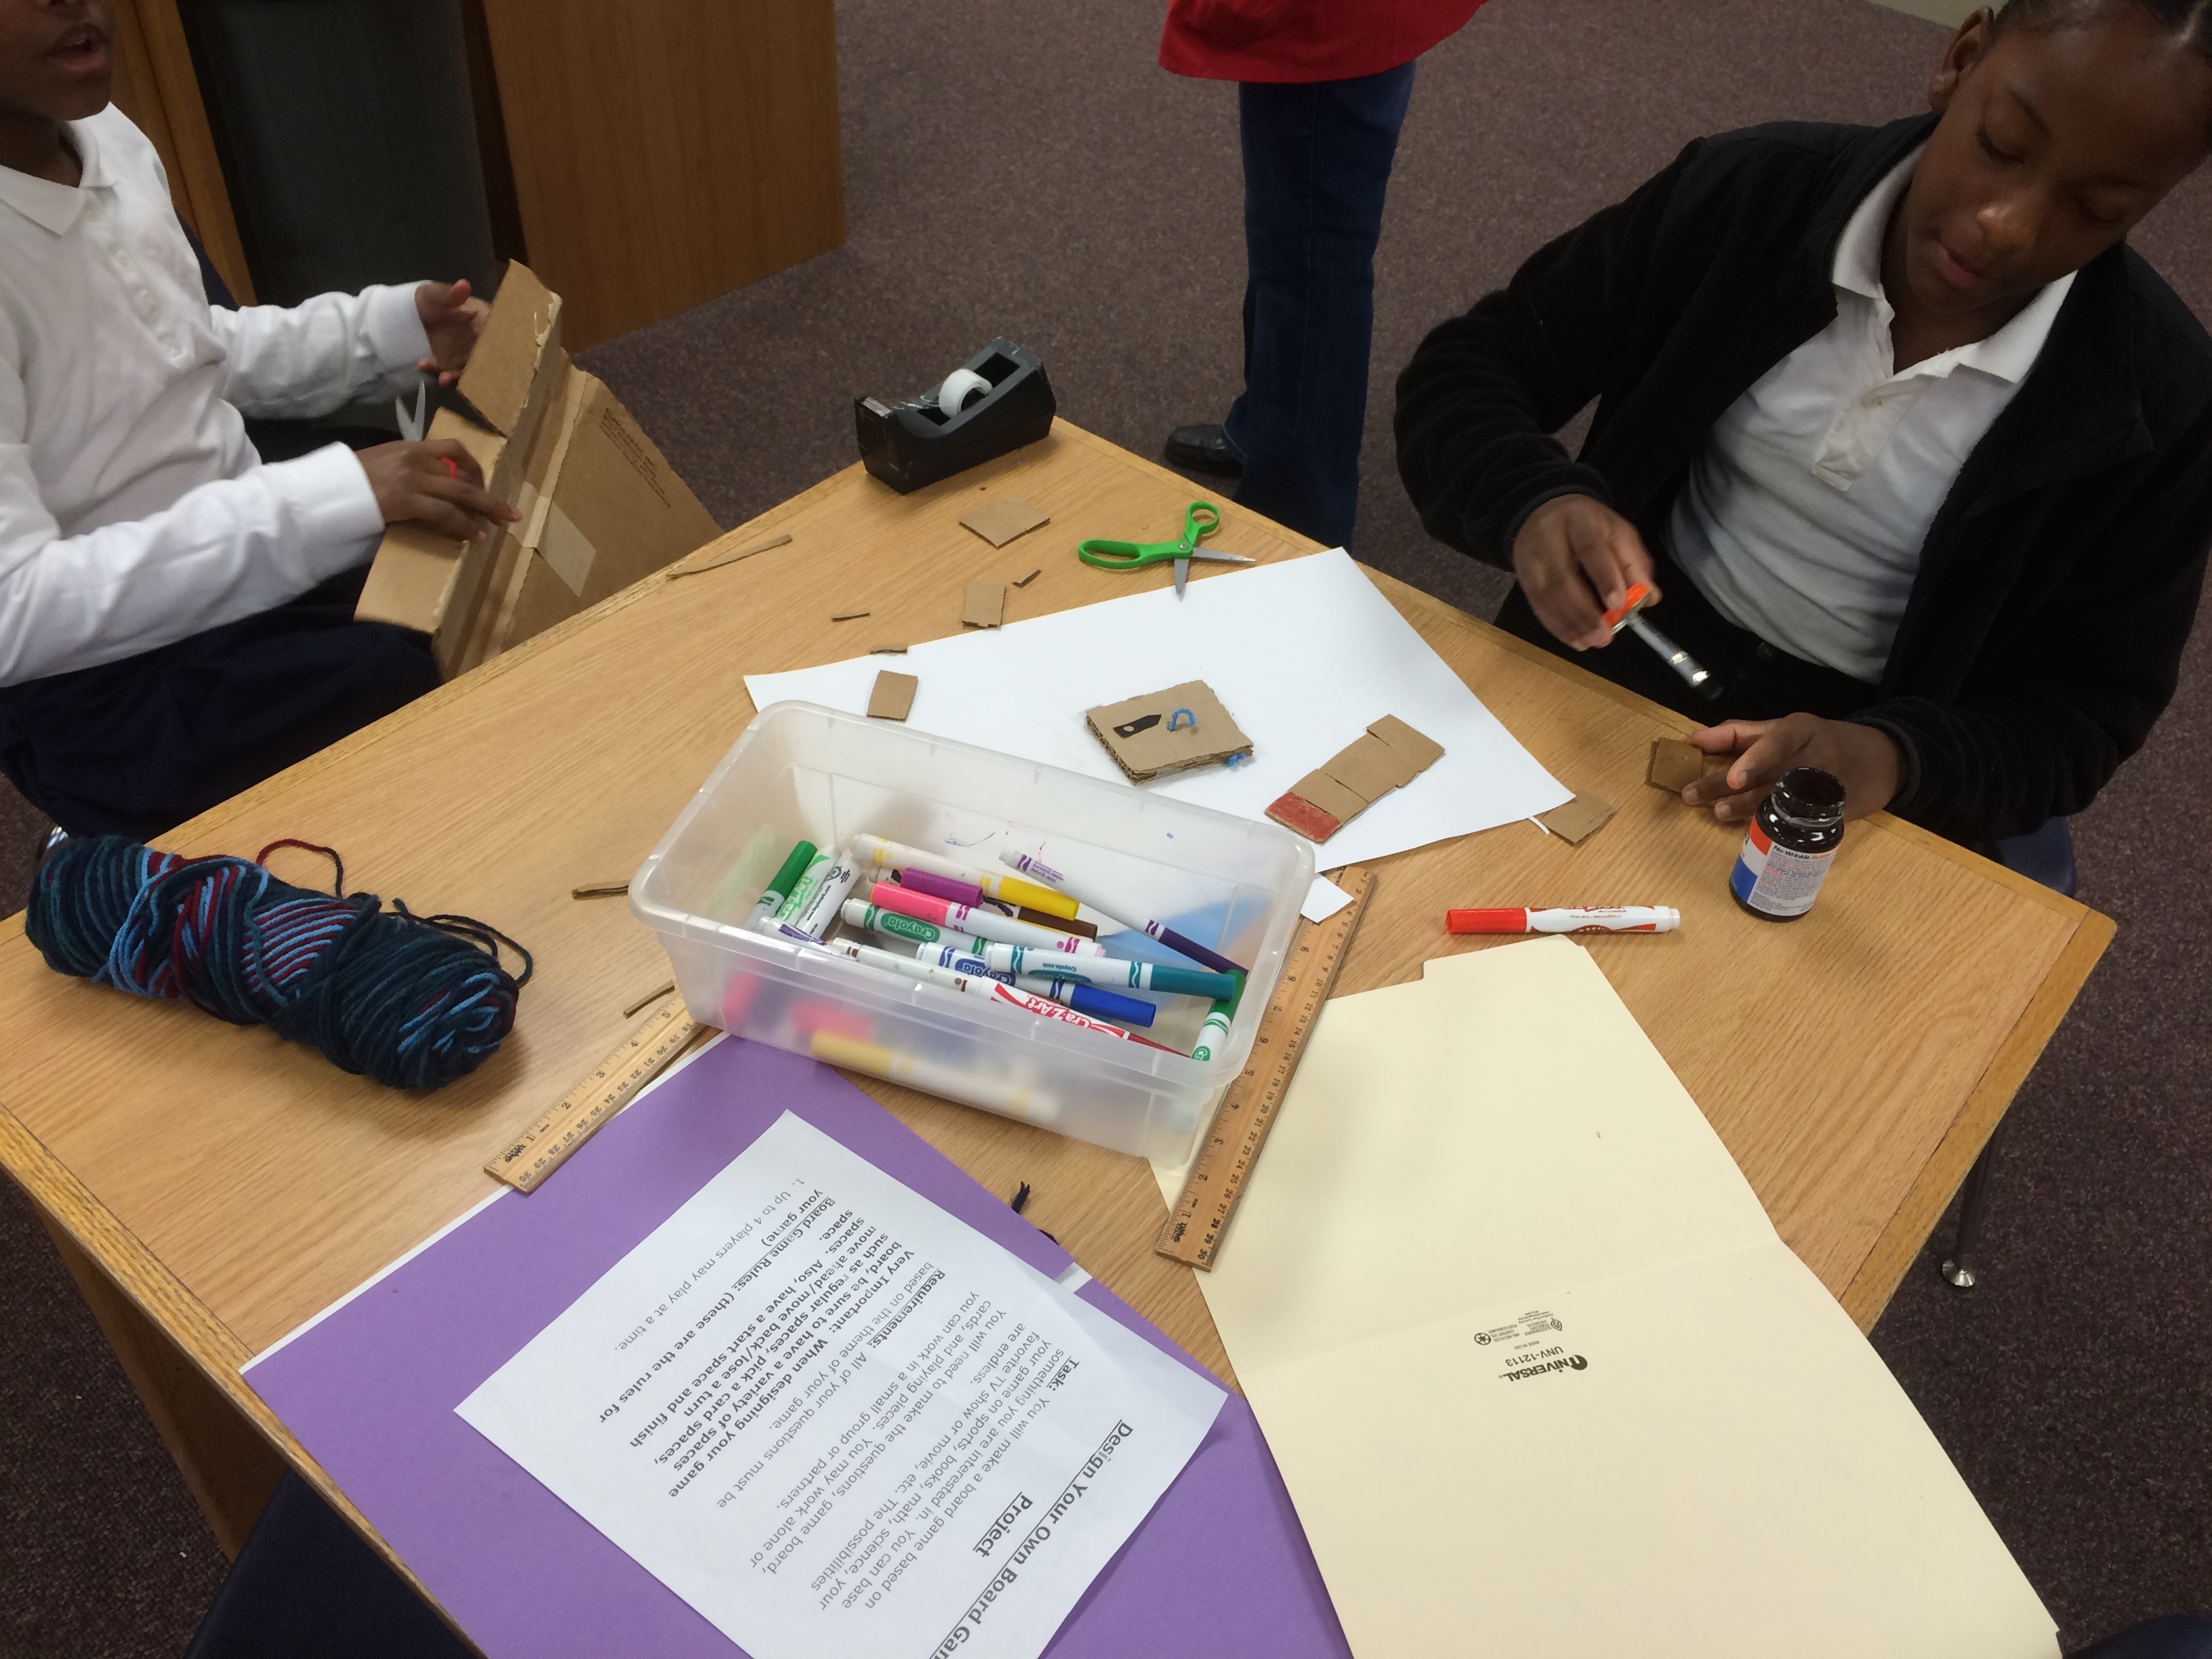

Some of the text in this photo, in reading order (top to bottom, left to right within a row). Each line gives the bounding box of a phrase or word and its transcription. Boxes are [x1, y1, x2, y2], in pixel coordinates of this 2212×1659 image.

[887, 916, 935, 941] Crayola
[962, 962, 1012, 986] Crayola
[1042, 962, 1077, 972] Crayola.com
[657, 1046, 668, 1055] 20
[1288, 1040, 1297, 1048] 15
[630, 1069, 642, 1079] 22
[590, 1106, 602, 1116] 25
[605, 1094, 615, 1103] 24
[1261, 1104, 1269, 1113] 20
[576, 1119, 588, 1128] 26
[774, 1191, 791, 1204] Up
[1224, 1188, 1233, 1199] 26
[1230, 1174, 1240, 1185] 25
[753, 1216, 761, 1225] 4
[761, 1189, 823, 1246] your game)
[819, 1209, 853, 1240] space.
[716, 1223, 753, 1258] players
[1197, 1249, 1208, 1259] 30
[692, 1258, 716, 1281] may
[599, 1196, 836, 1422] Board Game Rules: (these are the rules for
[653, 1304, 668, 1316] at
[668, 1280, 691, 1304] play
[615, 1326, 647, 1350] time.
[629, 1217, 864, 1447] spaces. Also, have start space and finish
[683, 1225, 876, 1416] move ahead/move back/lose turn
[654, 1233, 888, 1464] such as regular spaces, pick card spaces,
[673, 1241, 902, 1471] board, be sure have variety spaces
[769, 1262, 934, 1429] based the theme your game.
[970, 1323, 1025, 1383] are endless.
[1505, 1346, 1563, 1366] UNV-12113
[668, 1250, 914, 1496] Very Important: When designing your game
[716, 1267, 945, 1507] Requirements: All your questions must be
[777, 1291, 979, 1508] you can work in small group partners.
[762, 1300, 991, 1550] cards, and playing pieces. You may work alone
[762, 1310, 1006, 1574] You will need make the questions, game board,
[811, 1331, 1040, 1591] favorite TV show movie, etc. The possibilities
[1079, 1420, 1133, 1478] Design
[819, 1339, 1051, 1610] your game sports, books, math, science, your
[841, 1348, 1063, 1608] something you are interested in. You can base
[881, 1355, 1080, 1591] Task: You will make board game based
[1044, 1477, 1088, 1524] Your
[972, 1491, 1033, 1557] Project
[1010, 1521, 1050, 1564] Own
[964, 1564, 1018, 1625] Board
